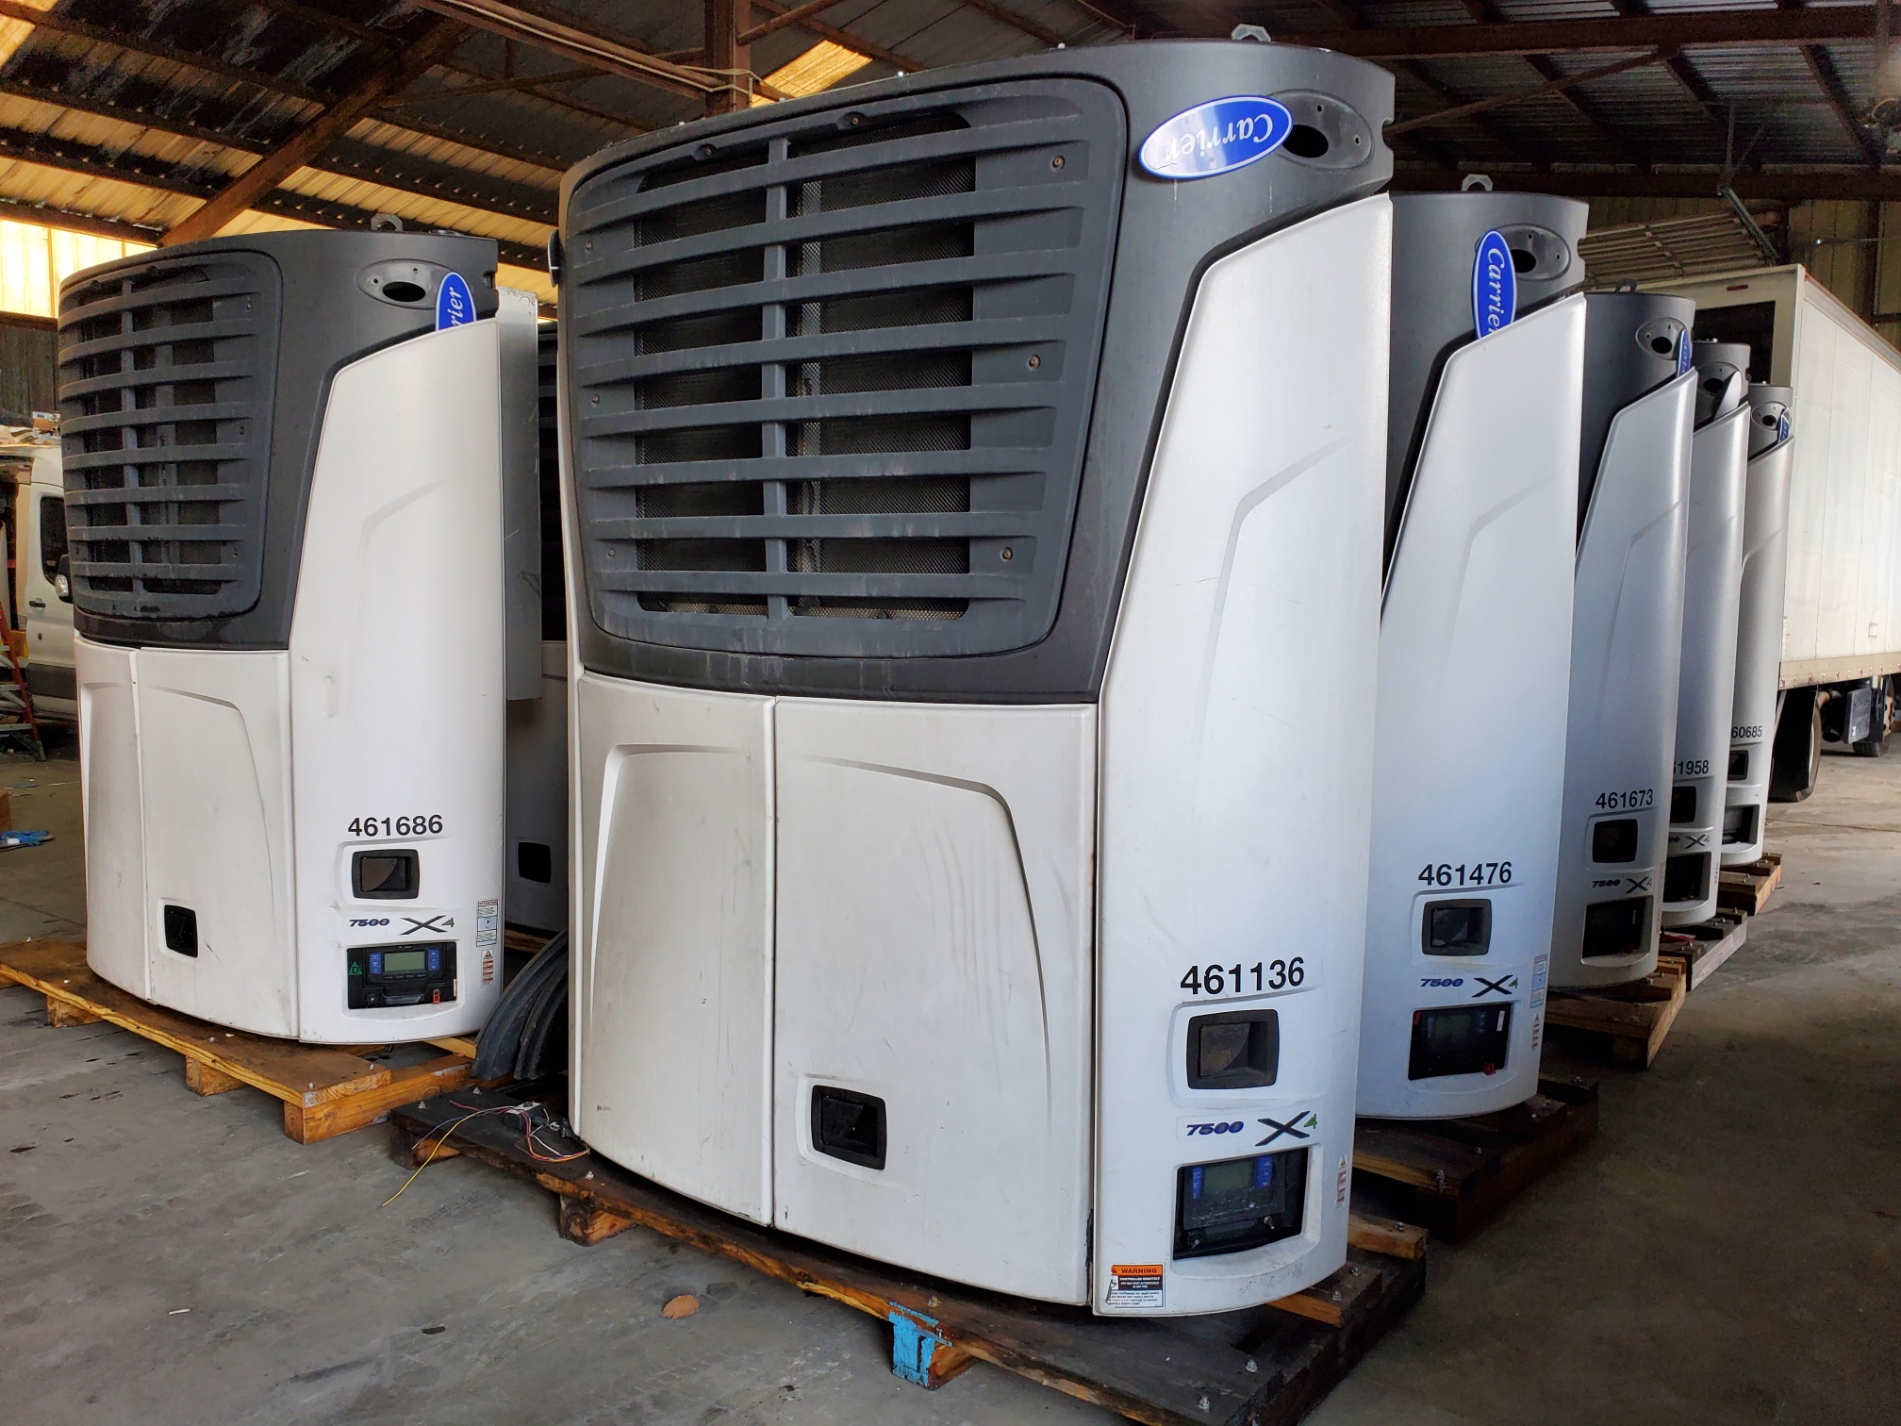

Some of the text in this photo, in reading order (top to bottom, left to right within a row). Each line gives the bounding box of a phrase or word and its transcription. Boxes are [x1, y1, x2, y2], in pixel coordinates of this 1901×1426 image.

[1165, 113, 1274, 160] Carrier
[1595, 788, 1654, 810] 461673
[347, 814, 444, 837] 461686
[1418, 861, 1513, 886] 461476
[349, 918, 390, 927] 7500
[1180, 956, 1305, 995] 461136
[1420, 978, 1464, 988] 7500
[1186, 1120, 1245, 1136] 7500
